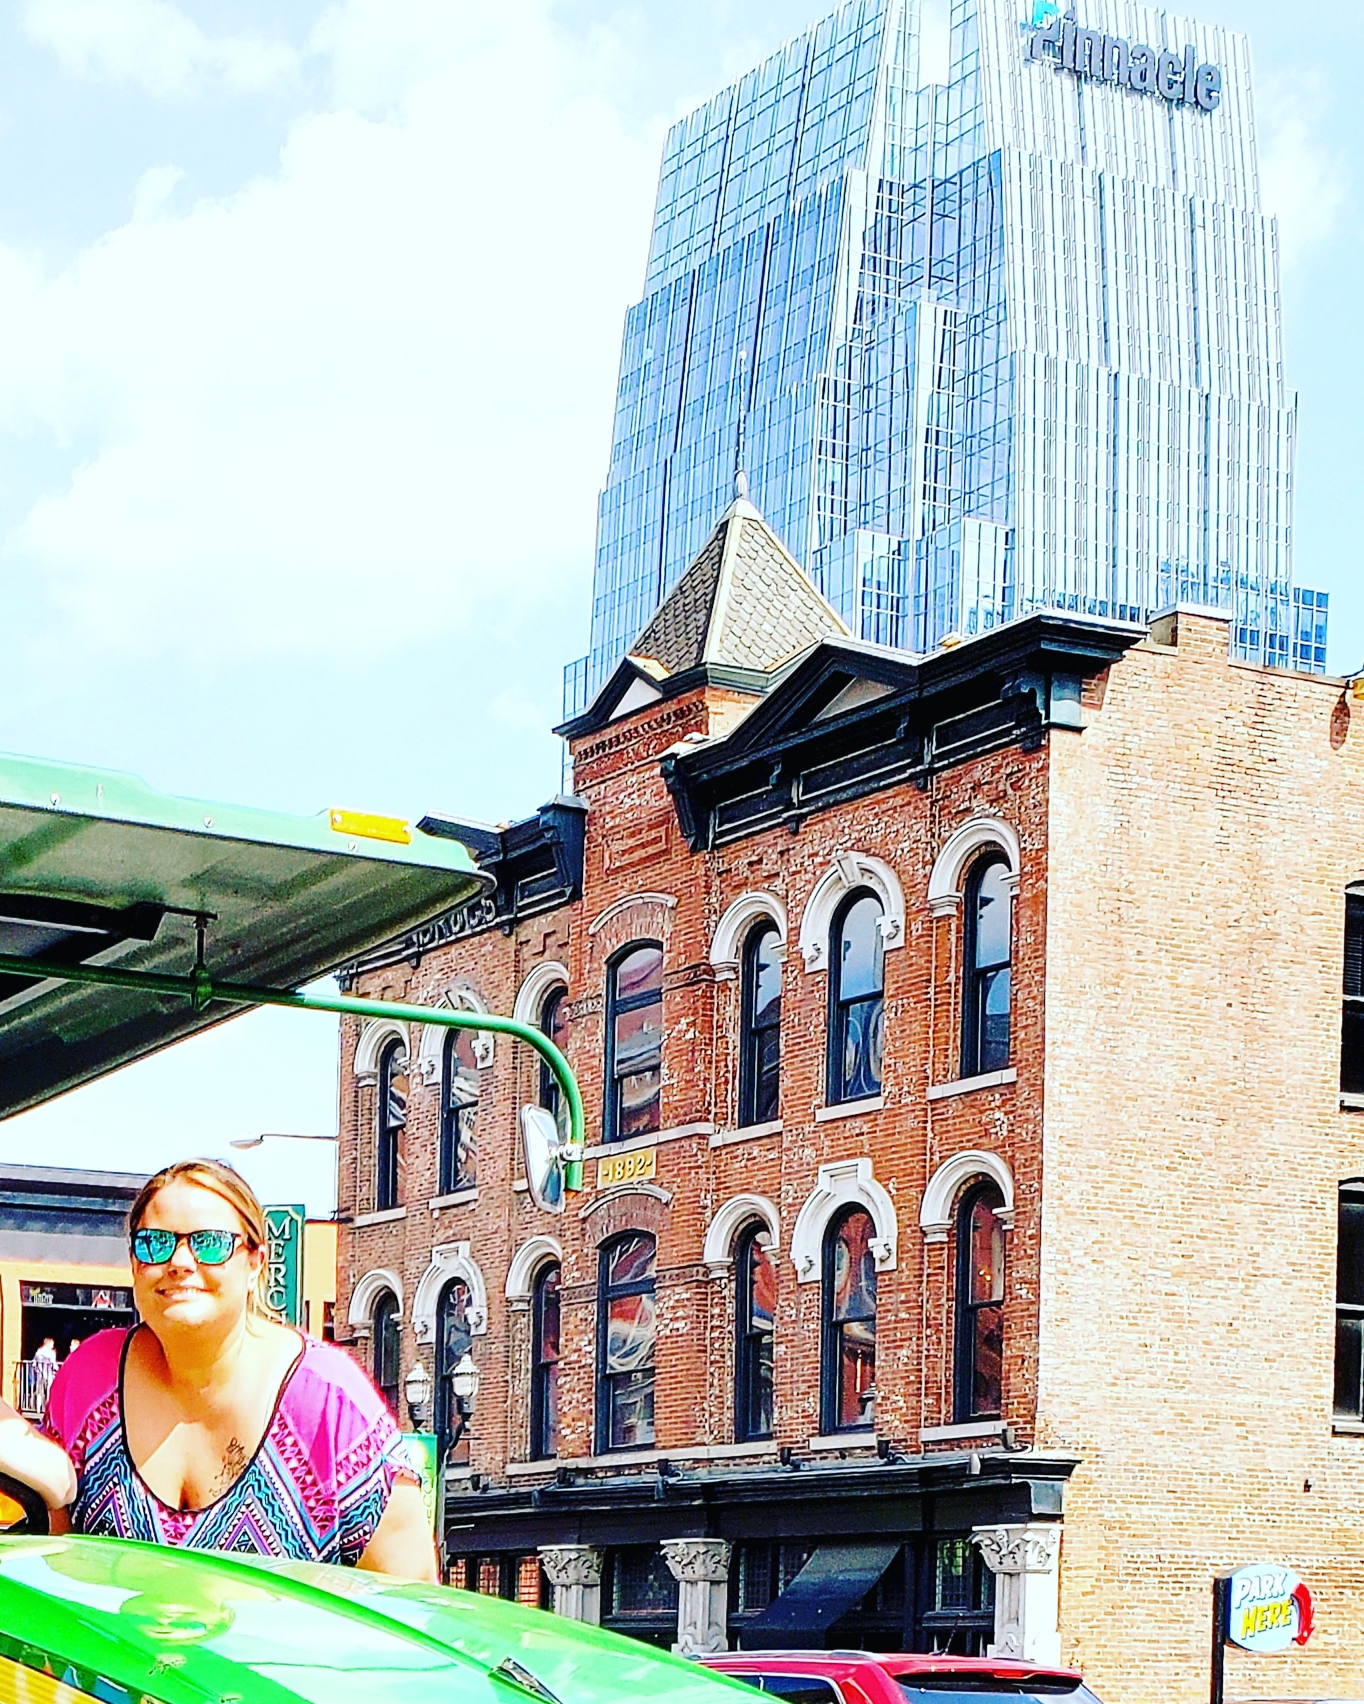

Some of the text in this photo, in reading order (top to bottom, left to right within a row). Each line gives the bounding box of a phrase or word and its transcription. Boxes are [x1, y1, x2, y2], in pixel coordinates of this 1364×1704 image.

[1029, 8, 1222, 111] Pinnacle
[1235, 1572, 1288, 1609] PARK
[1240, 1598, 1292, 1640] HERE
